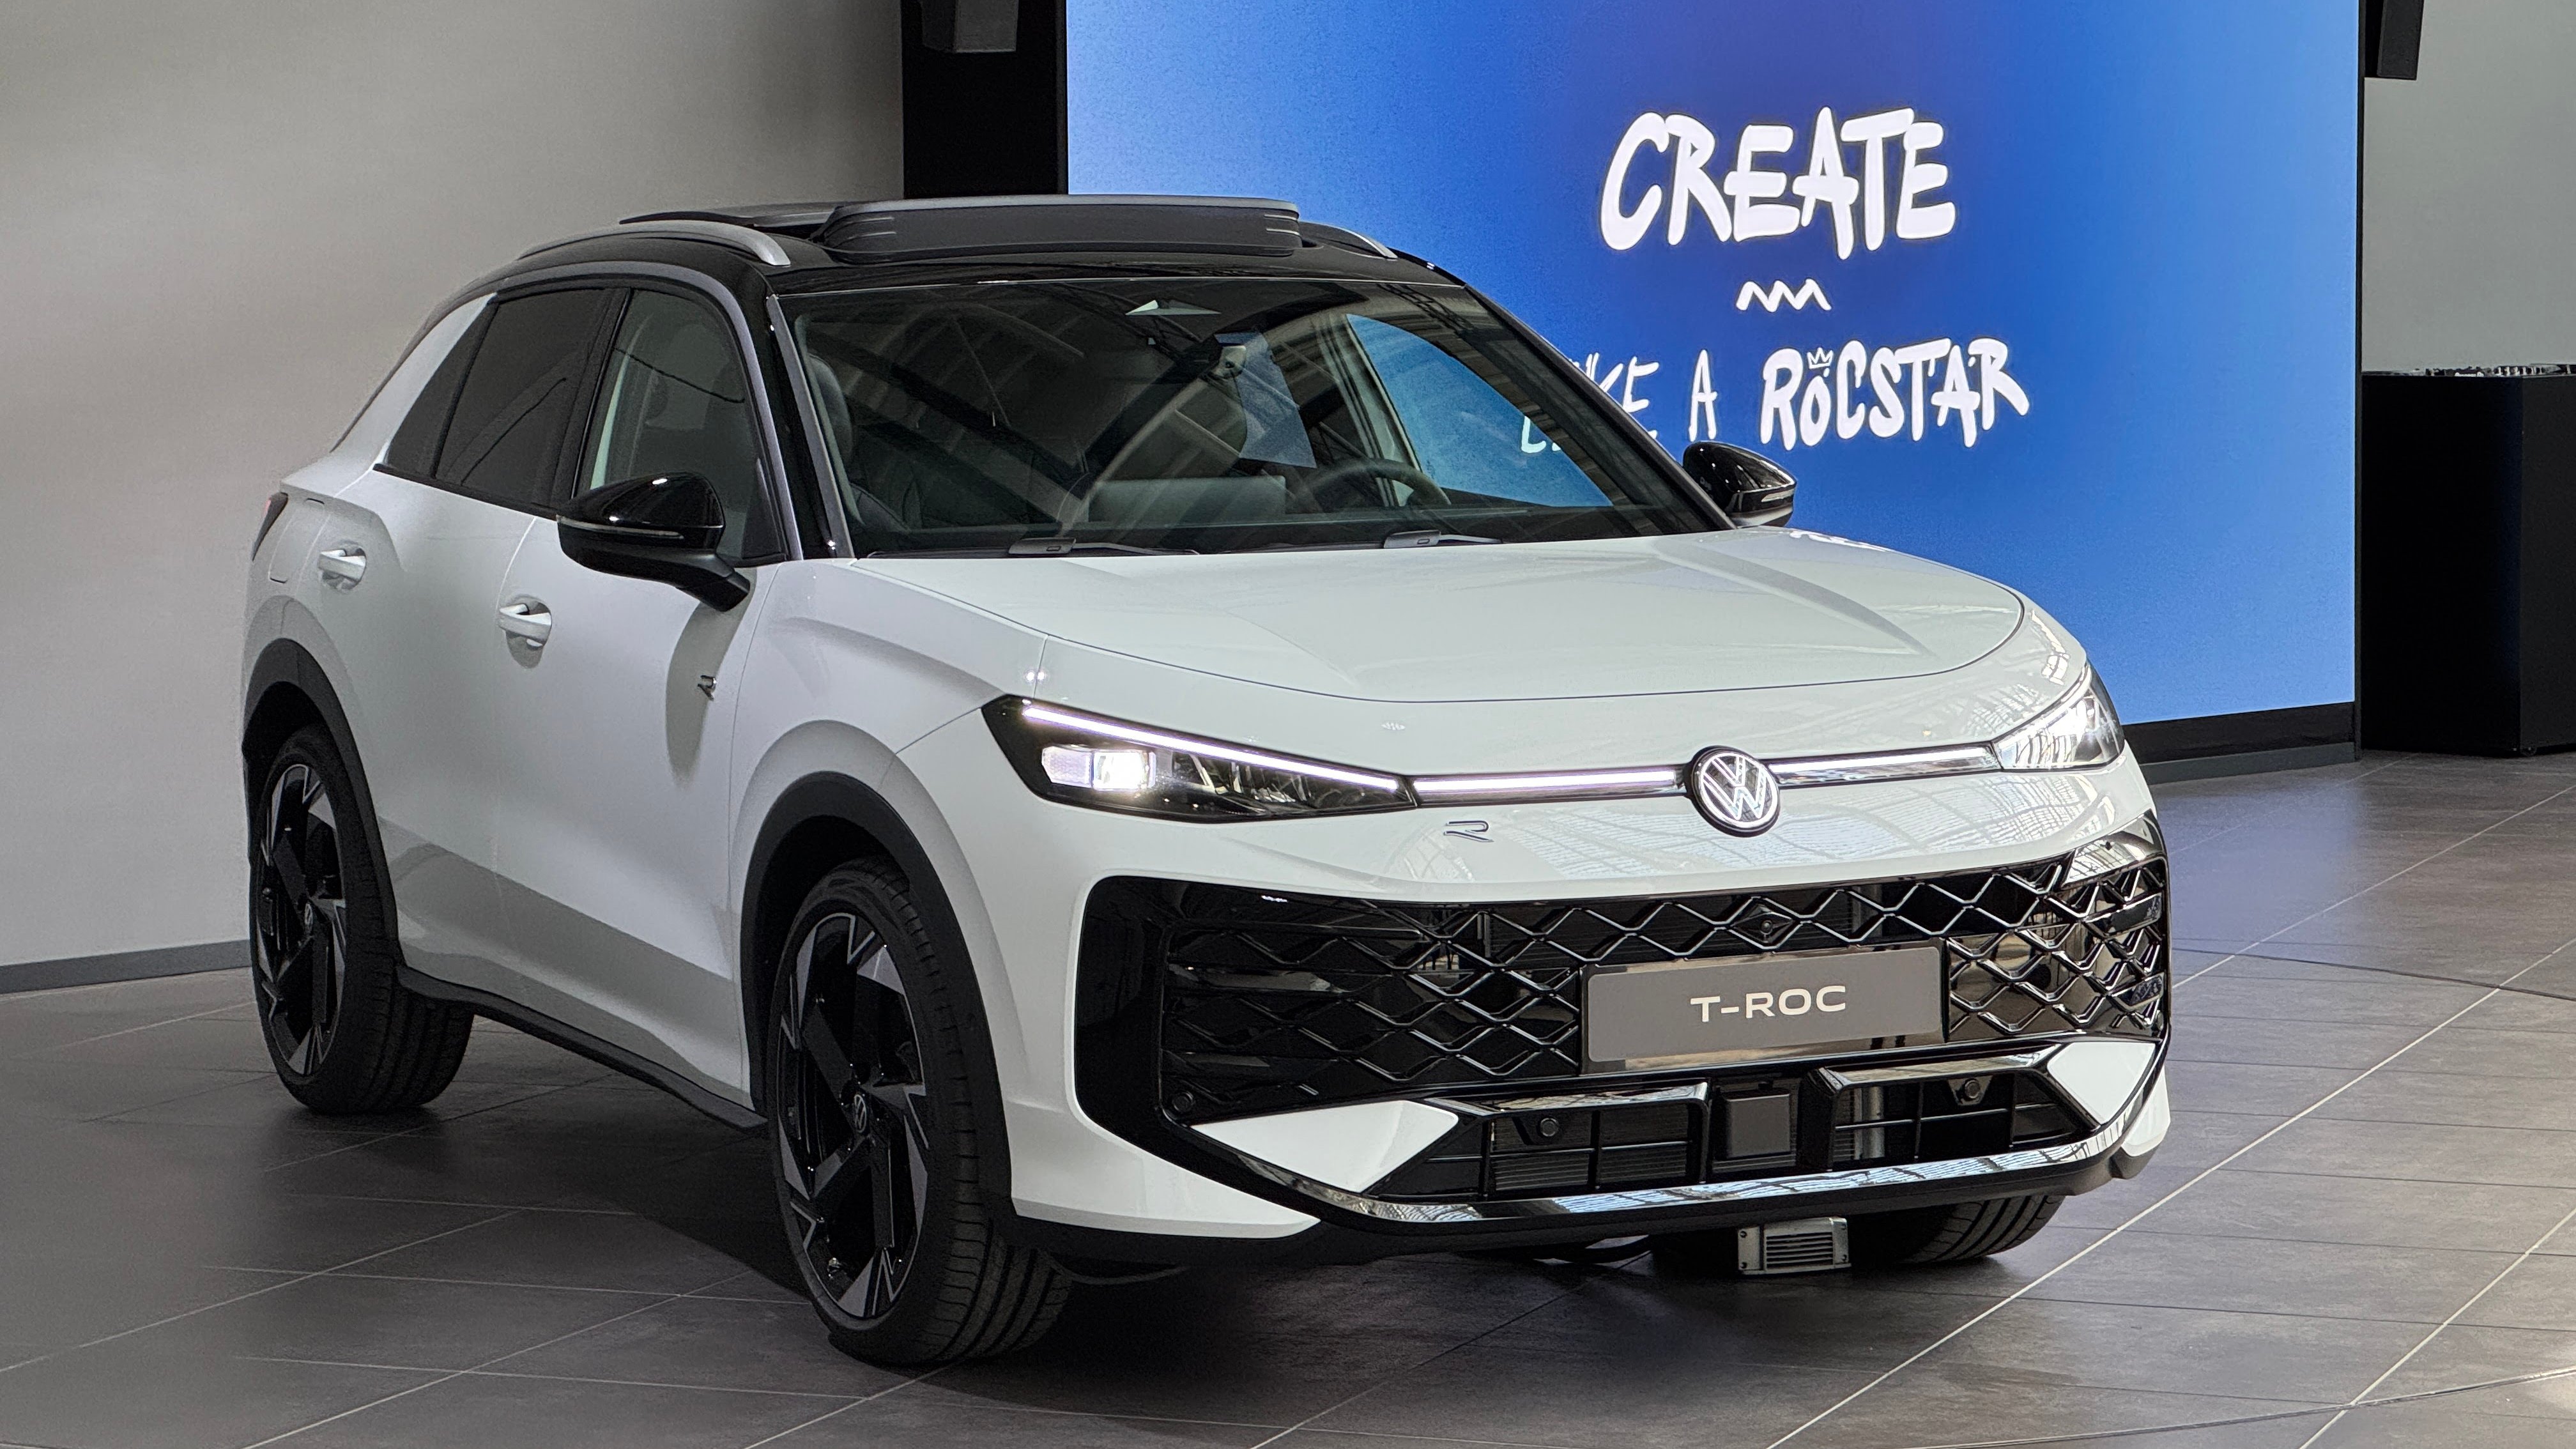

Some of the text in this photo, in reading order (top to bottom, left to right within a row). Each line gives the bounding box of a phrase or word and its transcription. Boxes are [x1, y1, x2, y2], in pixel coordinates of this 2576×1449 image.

[1600, 107, 1956, 260] CREATE
[1689, 349, 1718, 442] A
[1690, 985, 1846, 1022] T-ROC
